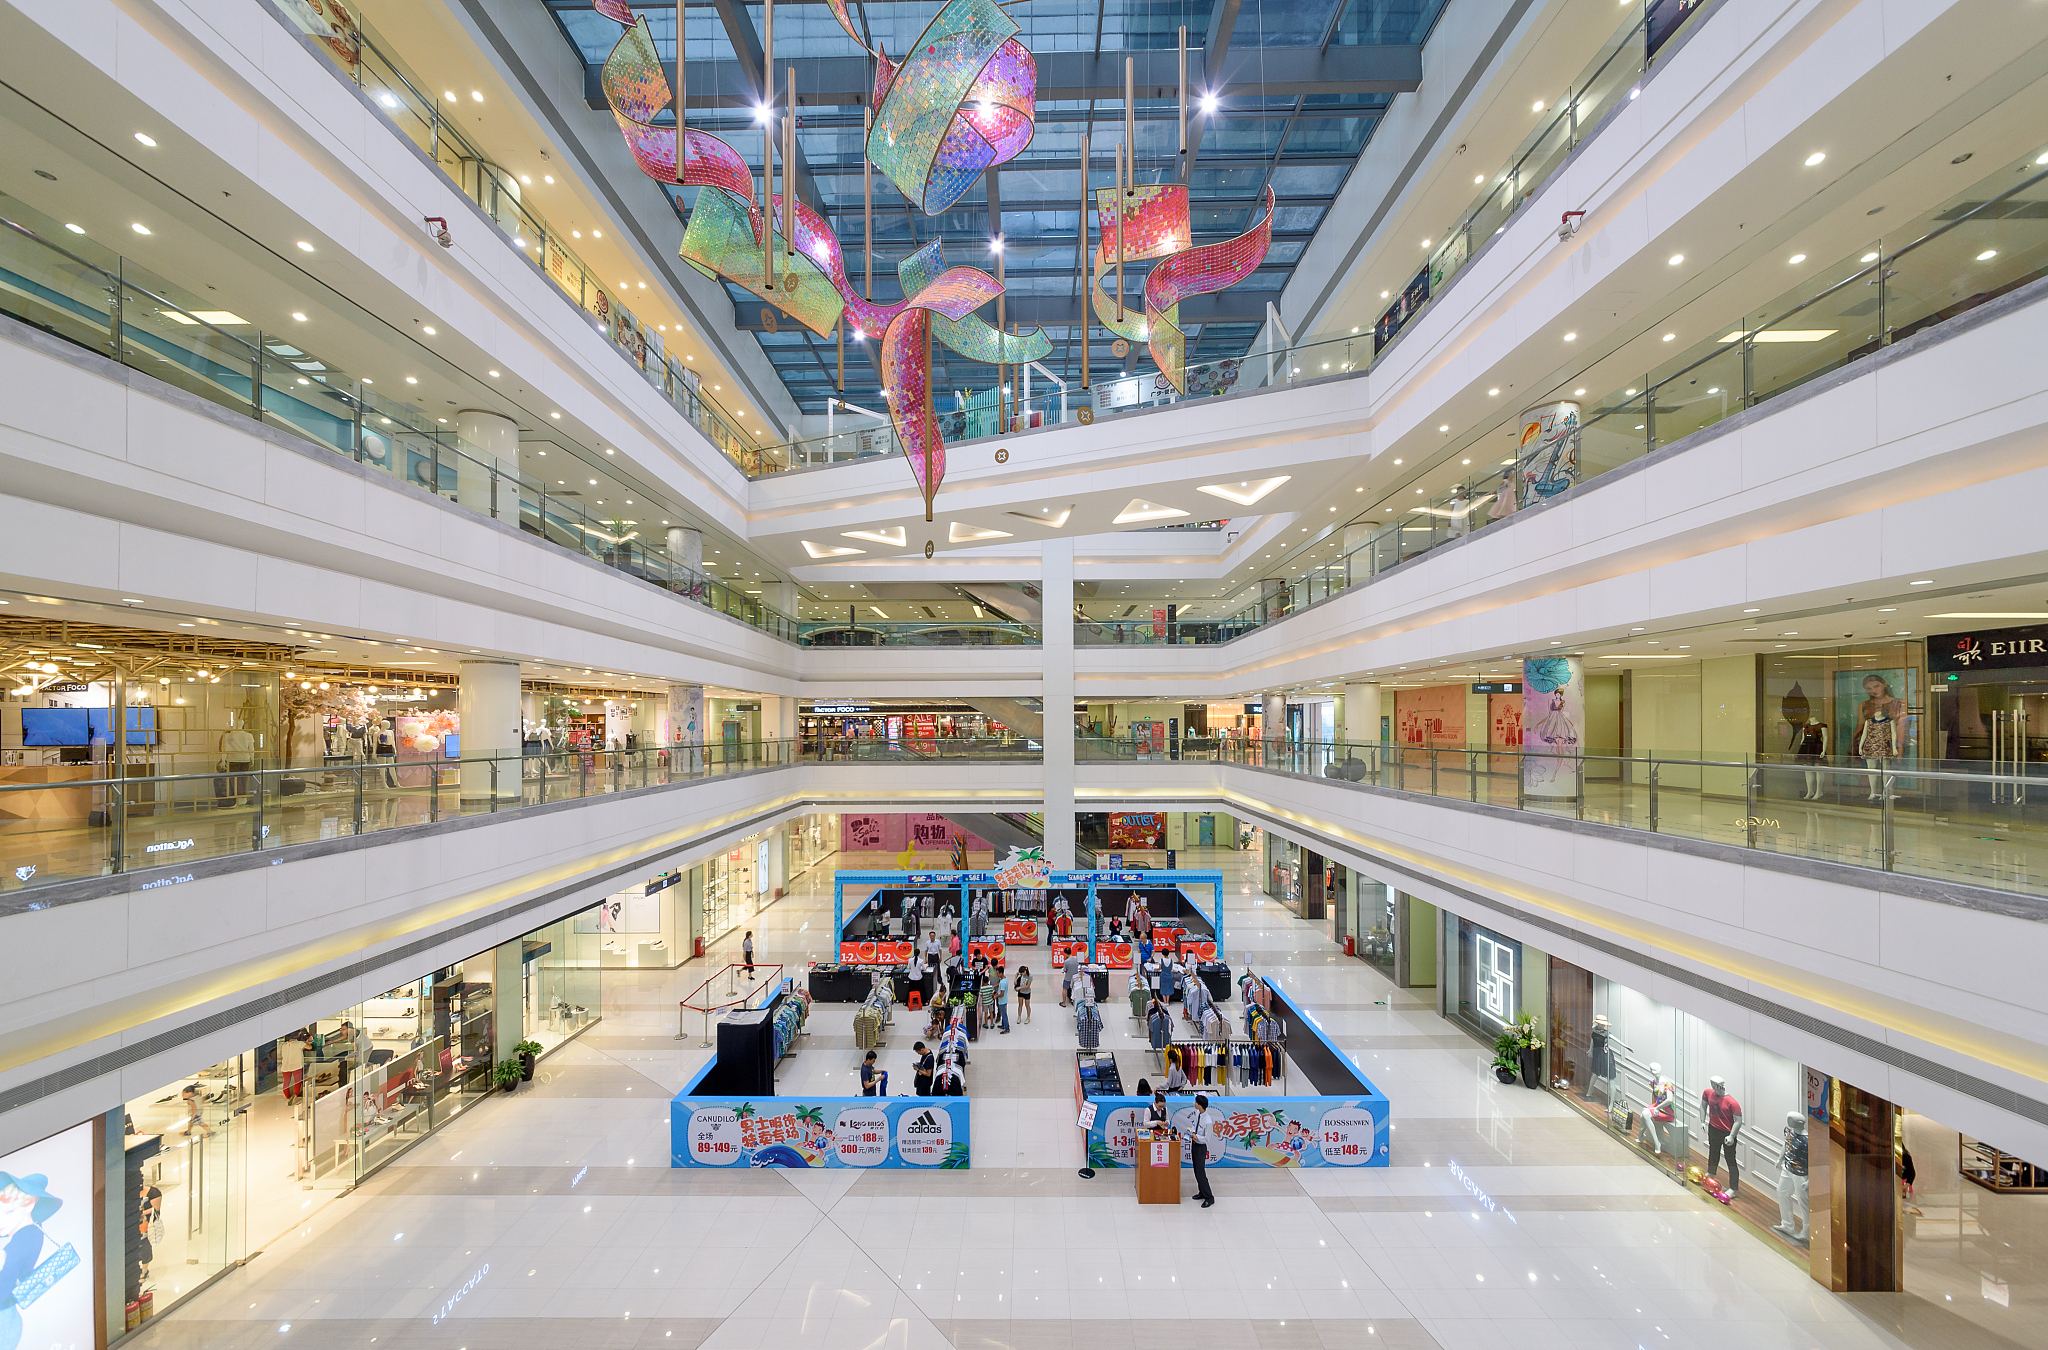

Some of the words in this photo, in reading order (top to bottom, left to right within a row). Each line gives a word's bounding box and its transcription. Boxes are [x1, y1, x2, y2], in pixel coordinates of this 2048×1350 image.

[66, 683, 87, 692] FOCO
[913, 824, 946, 845] 购物
[696, 1115, 736, 1123] CANUDILO
[740, 1113, 797, 1134] 男士服饰
[907, 1124, 942, 1134] adidas
[697, 1131, 714, 1141] 全场
[741, 1127, 800, 1148] 特卖专场
[842, 1132, 885, 1143] 一口价188元
[1324, 1131, 1349, 1143] 1-3折
[697, 1142, 738, 1153] 89-149元
[840, 1144, 882, 1155] 300元/两件
[1113, 1147, 1136, 1158] 低至1
[1324, 1144, 1368, 1156] 低至148元
